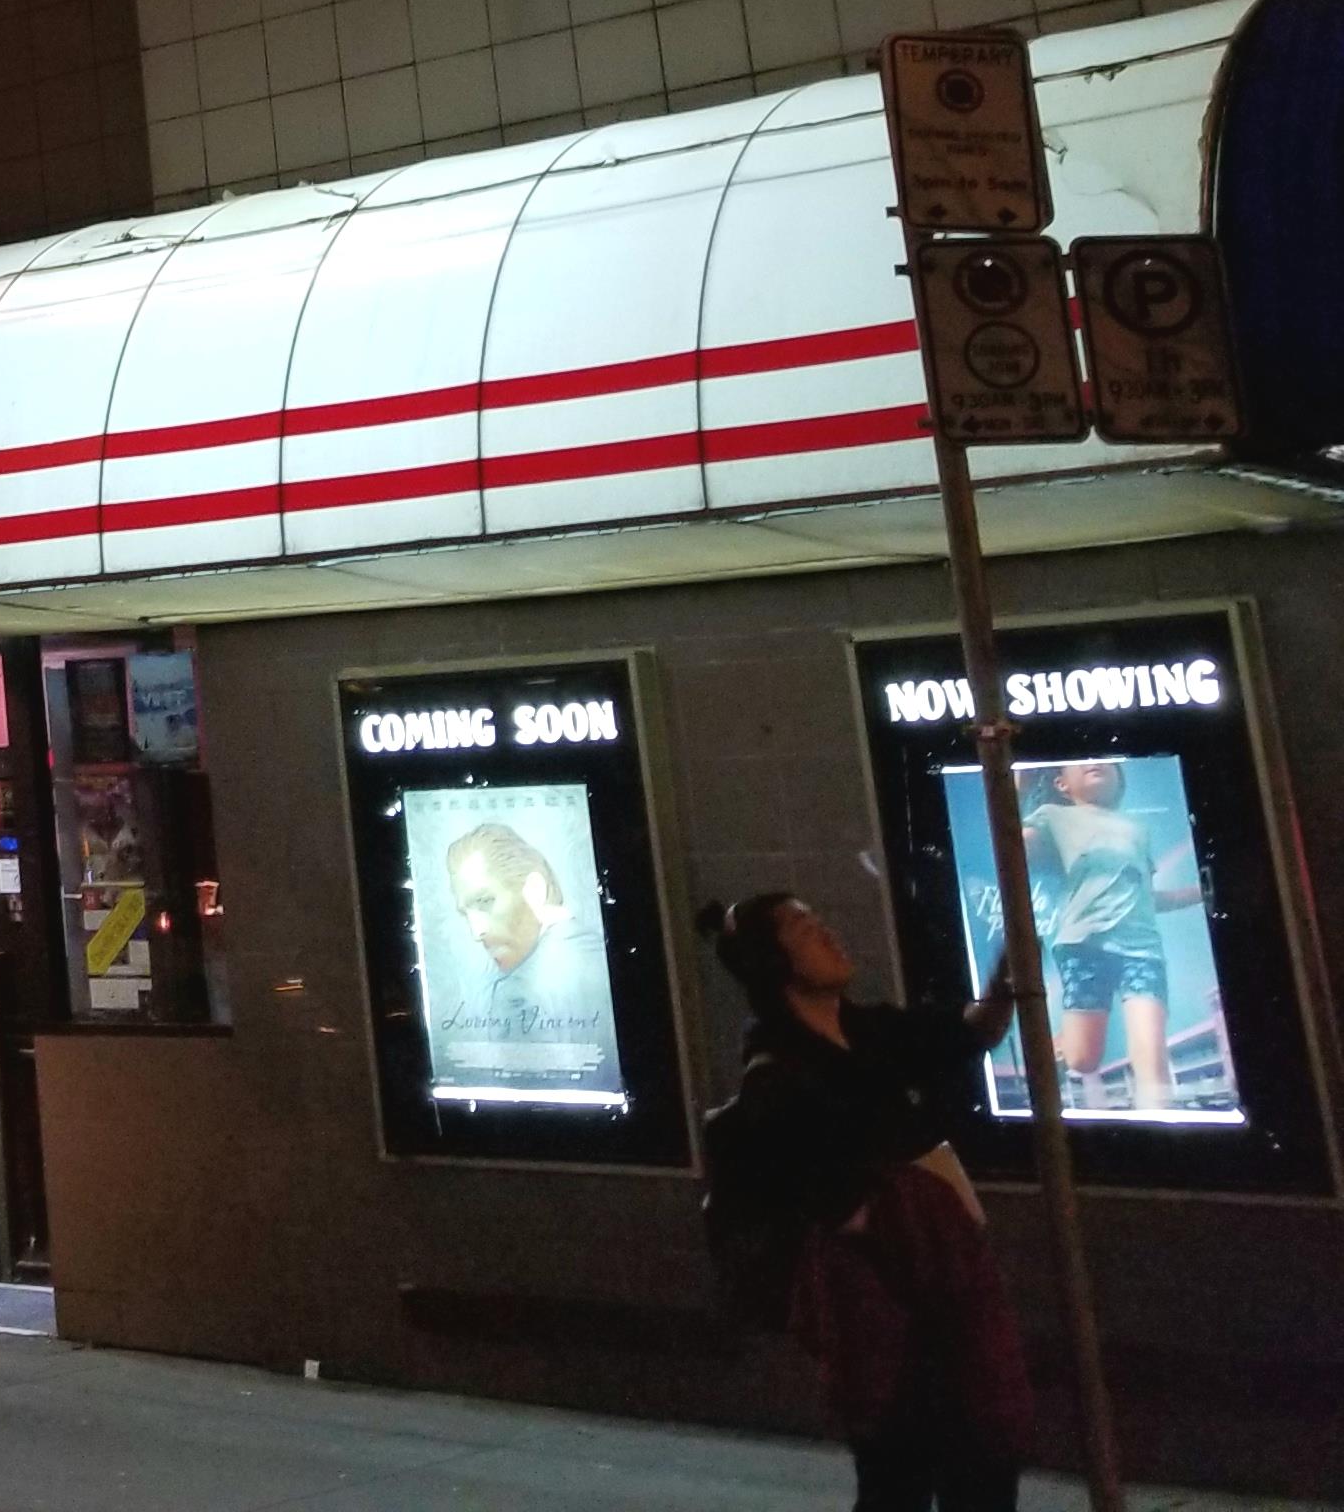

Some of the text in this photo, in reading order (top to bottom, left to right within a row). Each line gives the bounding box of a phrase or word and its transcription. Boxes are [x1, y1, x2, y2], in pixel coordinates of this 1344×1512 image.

[1005, 659, 1219, 716] SHOWING
[361, 700, 619, 753] COMING SOON
[441, 1001, 600, 1035] Loving Vincent
